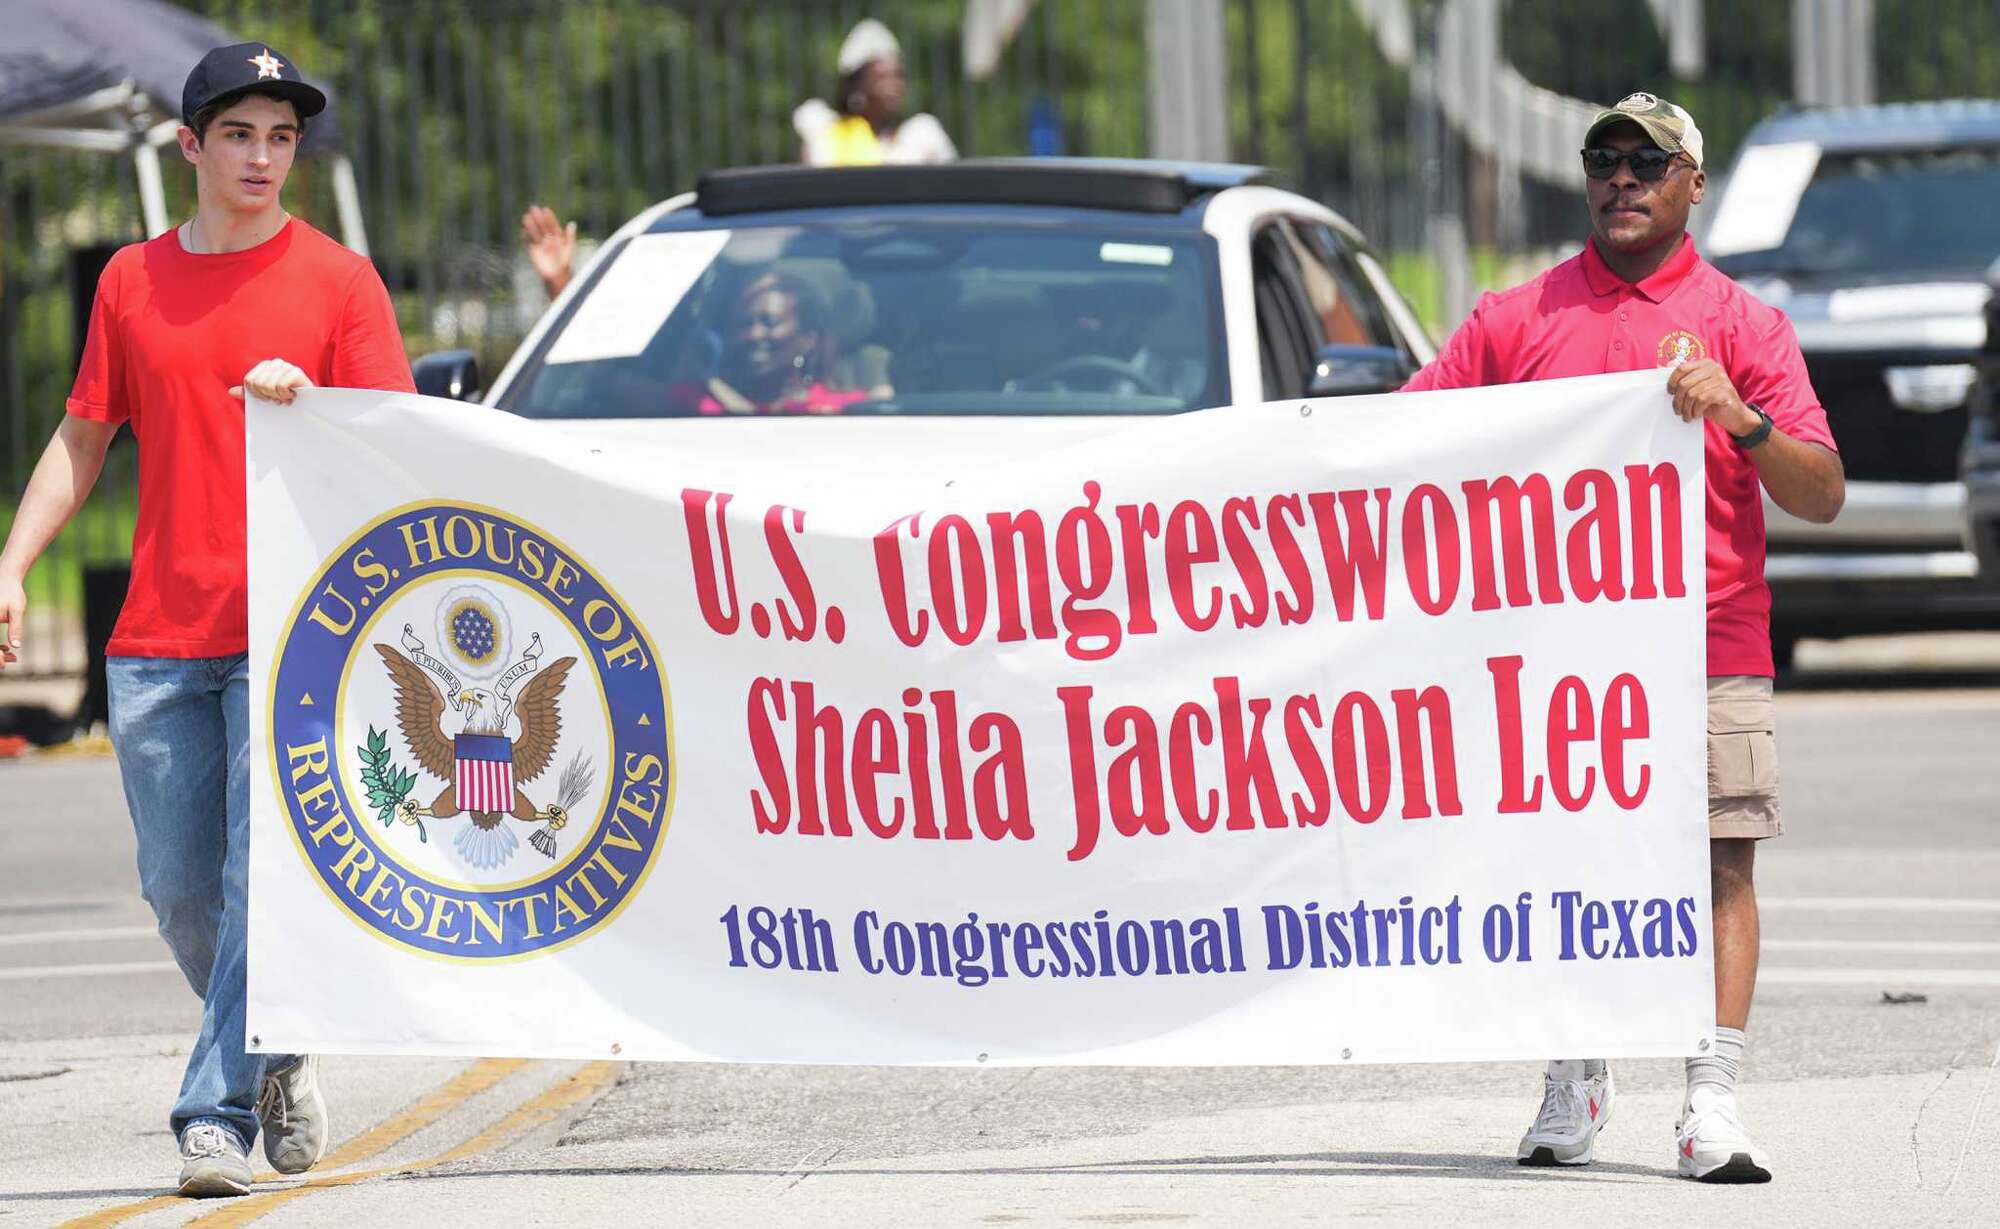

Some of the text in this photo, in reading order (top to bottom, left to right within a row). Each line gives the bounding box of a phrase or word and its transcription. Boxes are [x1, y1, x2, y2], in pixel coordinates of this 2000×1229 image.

[308, 515, 649, 672] U.S. HOUSE OF
[681, 462, 1687, 661] U.S. Congresswoman
[500, 663, 529, 689] UNUM
[747, 654, 1651, 862] Sheila Jackson Lee
[286, 735, 664, 945] REPRESENTATIVES
[720, 891, 1697, 987] 18th Congressional District of Texas
